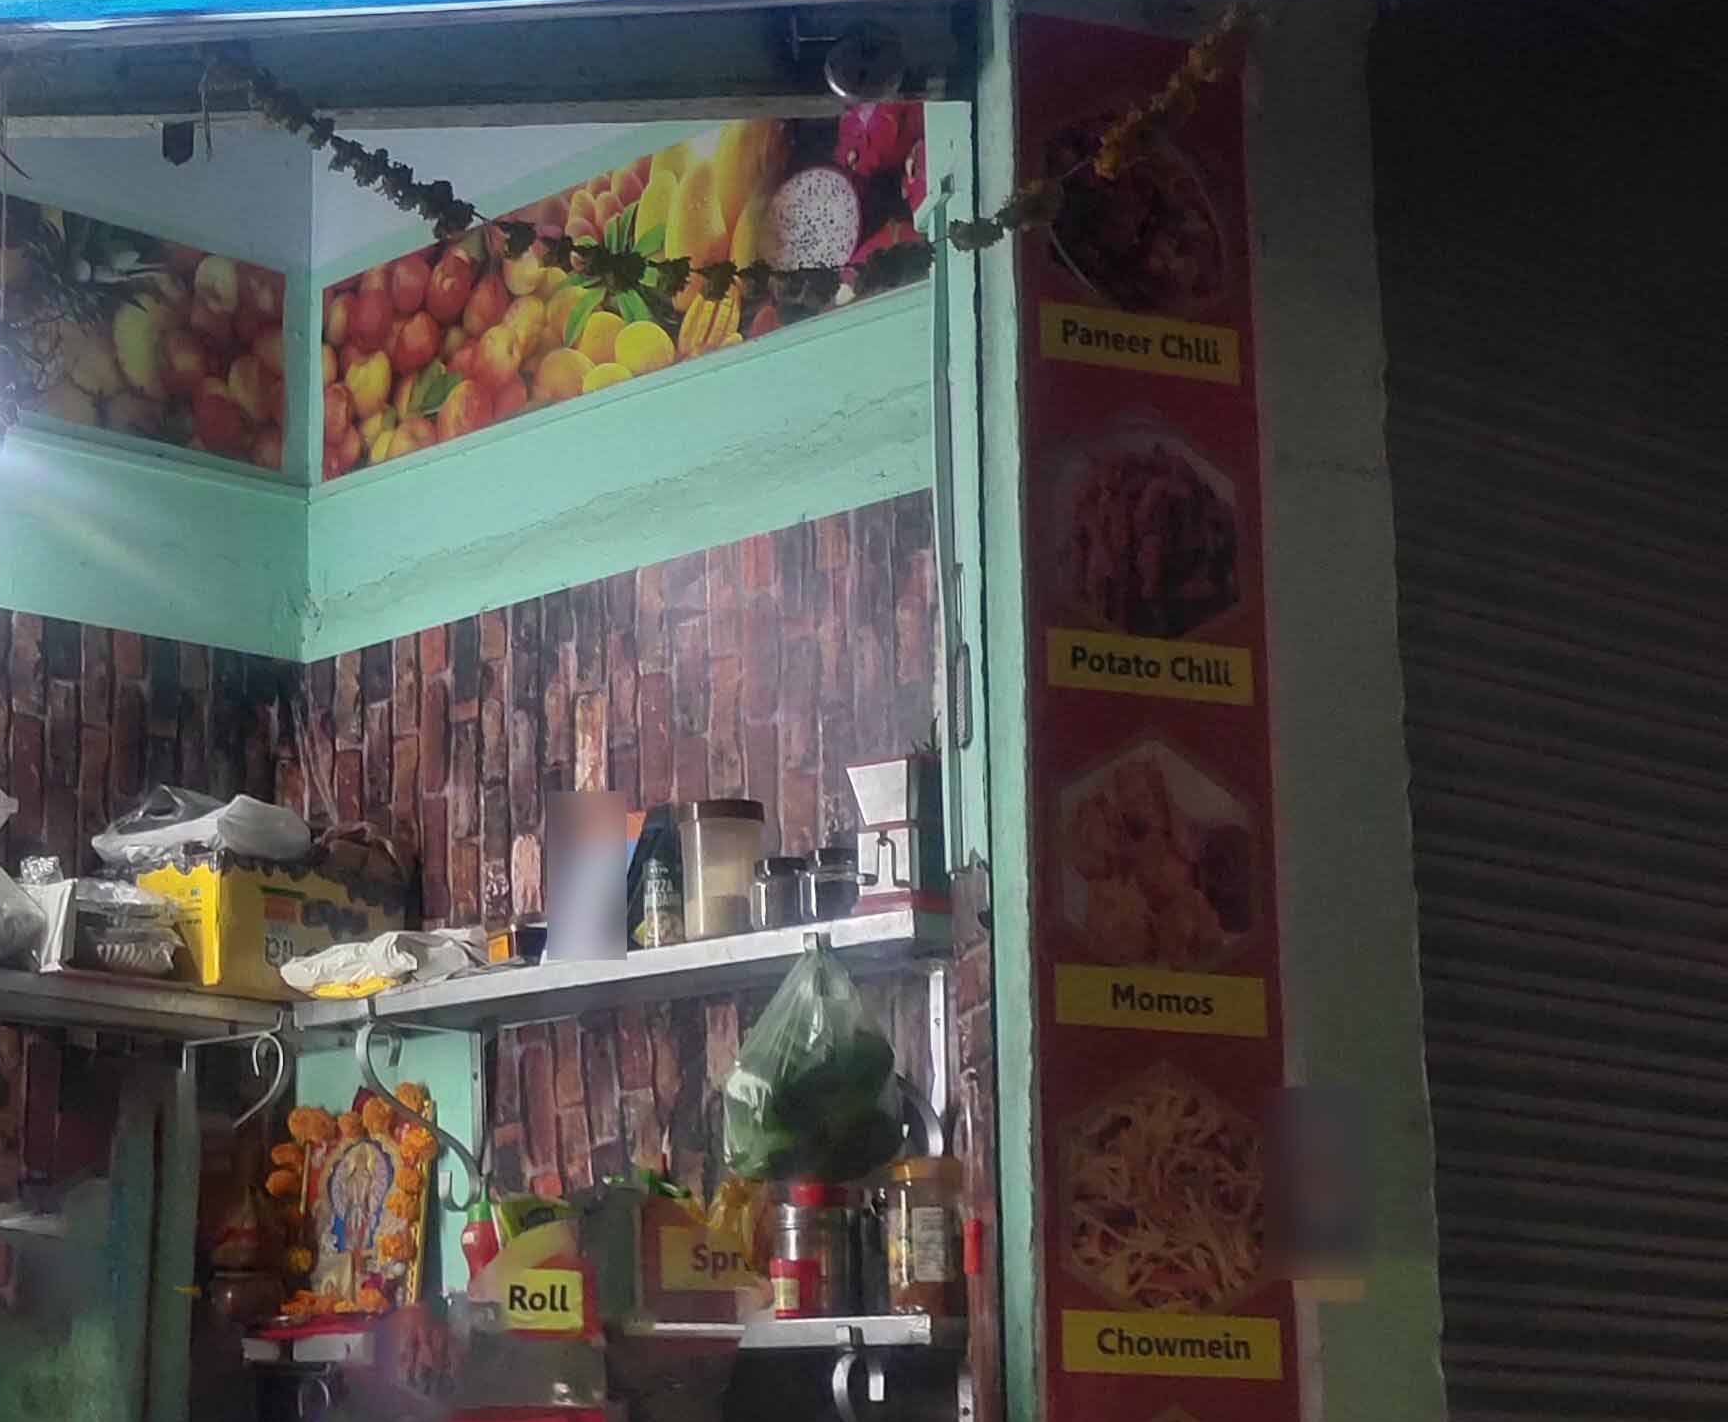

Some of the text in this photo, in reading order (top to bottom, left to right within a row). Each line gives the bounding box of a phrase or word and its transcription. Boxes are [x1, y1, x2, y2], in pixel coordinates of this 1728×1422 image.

[1061, 319, 1152, 355] Paneer
[1071, 646, 1161, 679] Potato
[1111, 982, 1214, 1016] Momos
[508, 1284, 570, 1312] Roll
[1096, 1327, 1251, 1360] Chowmein
